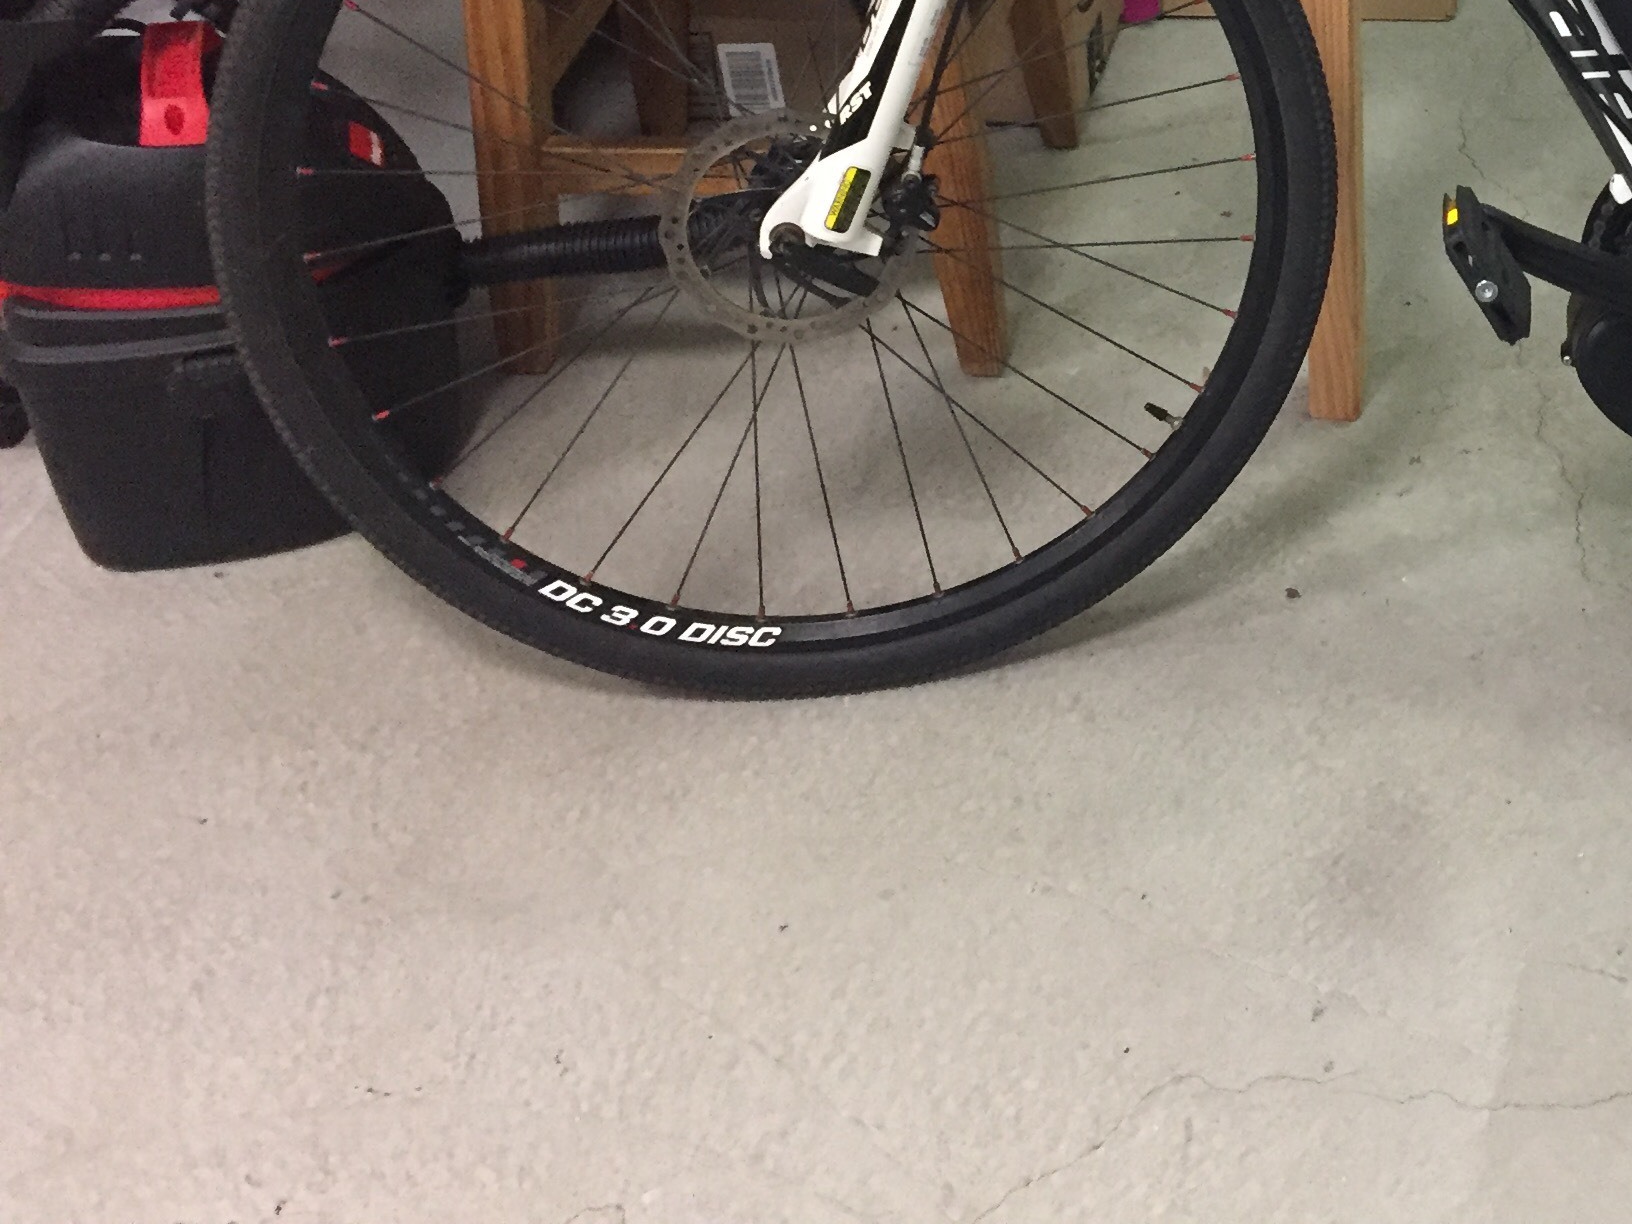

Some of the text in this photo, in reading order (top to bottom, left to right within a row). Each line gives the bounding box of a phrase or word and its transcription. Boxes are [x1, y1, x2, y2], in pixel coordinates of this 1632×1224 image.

[838, 80, 873, 126] RST
[537, 579, 604, 614] DC
[677, 621, 783, 649] DISC
